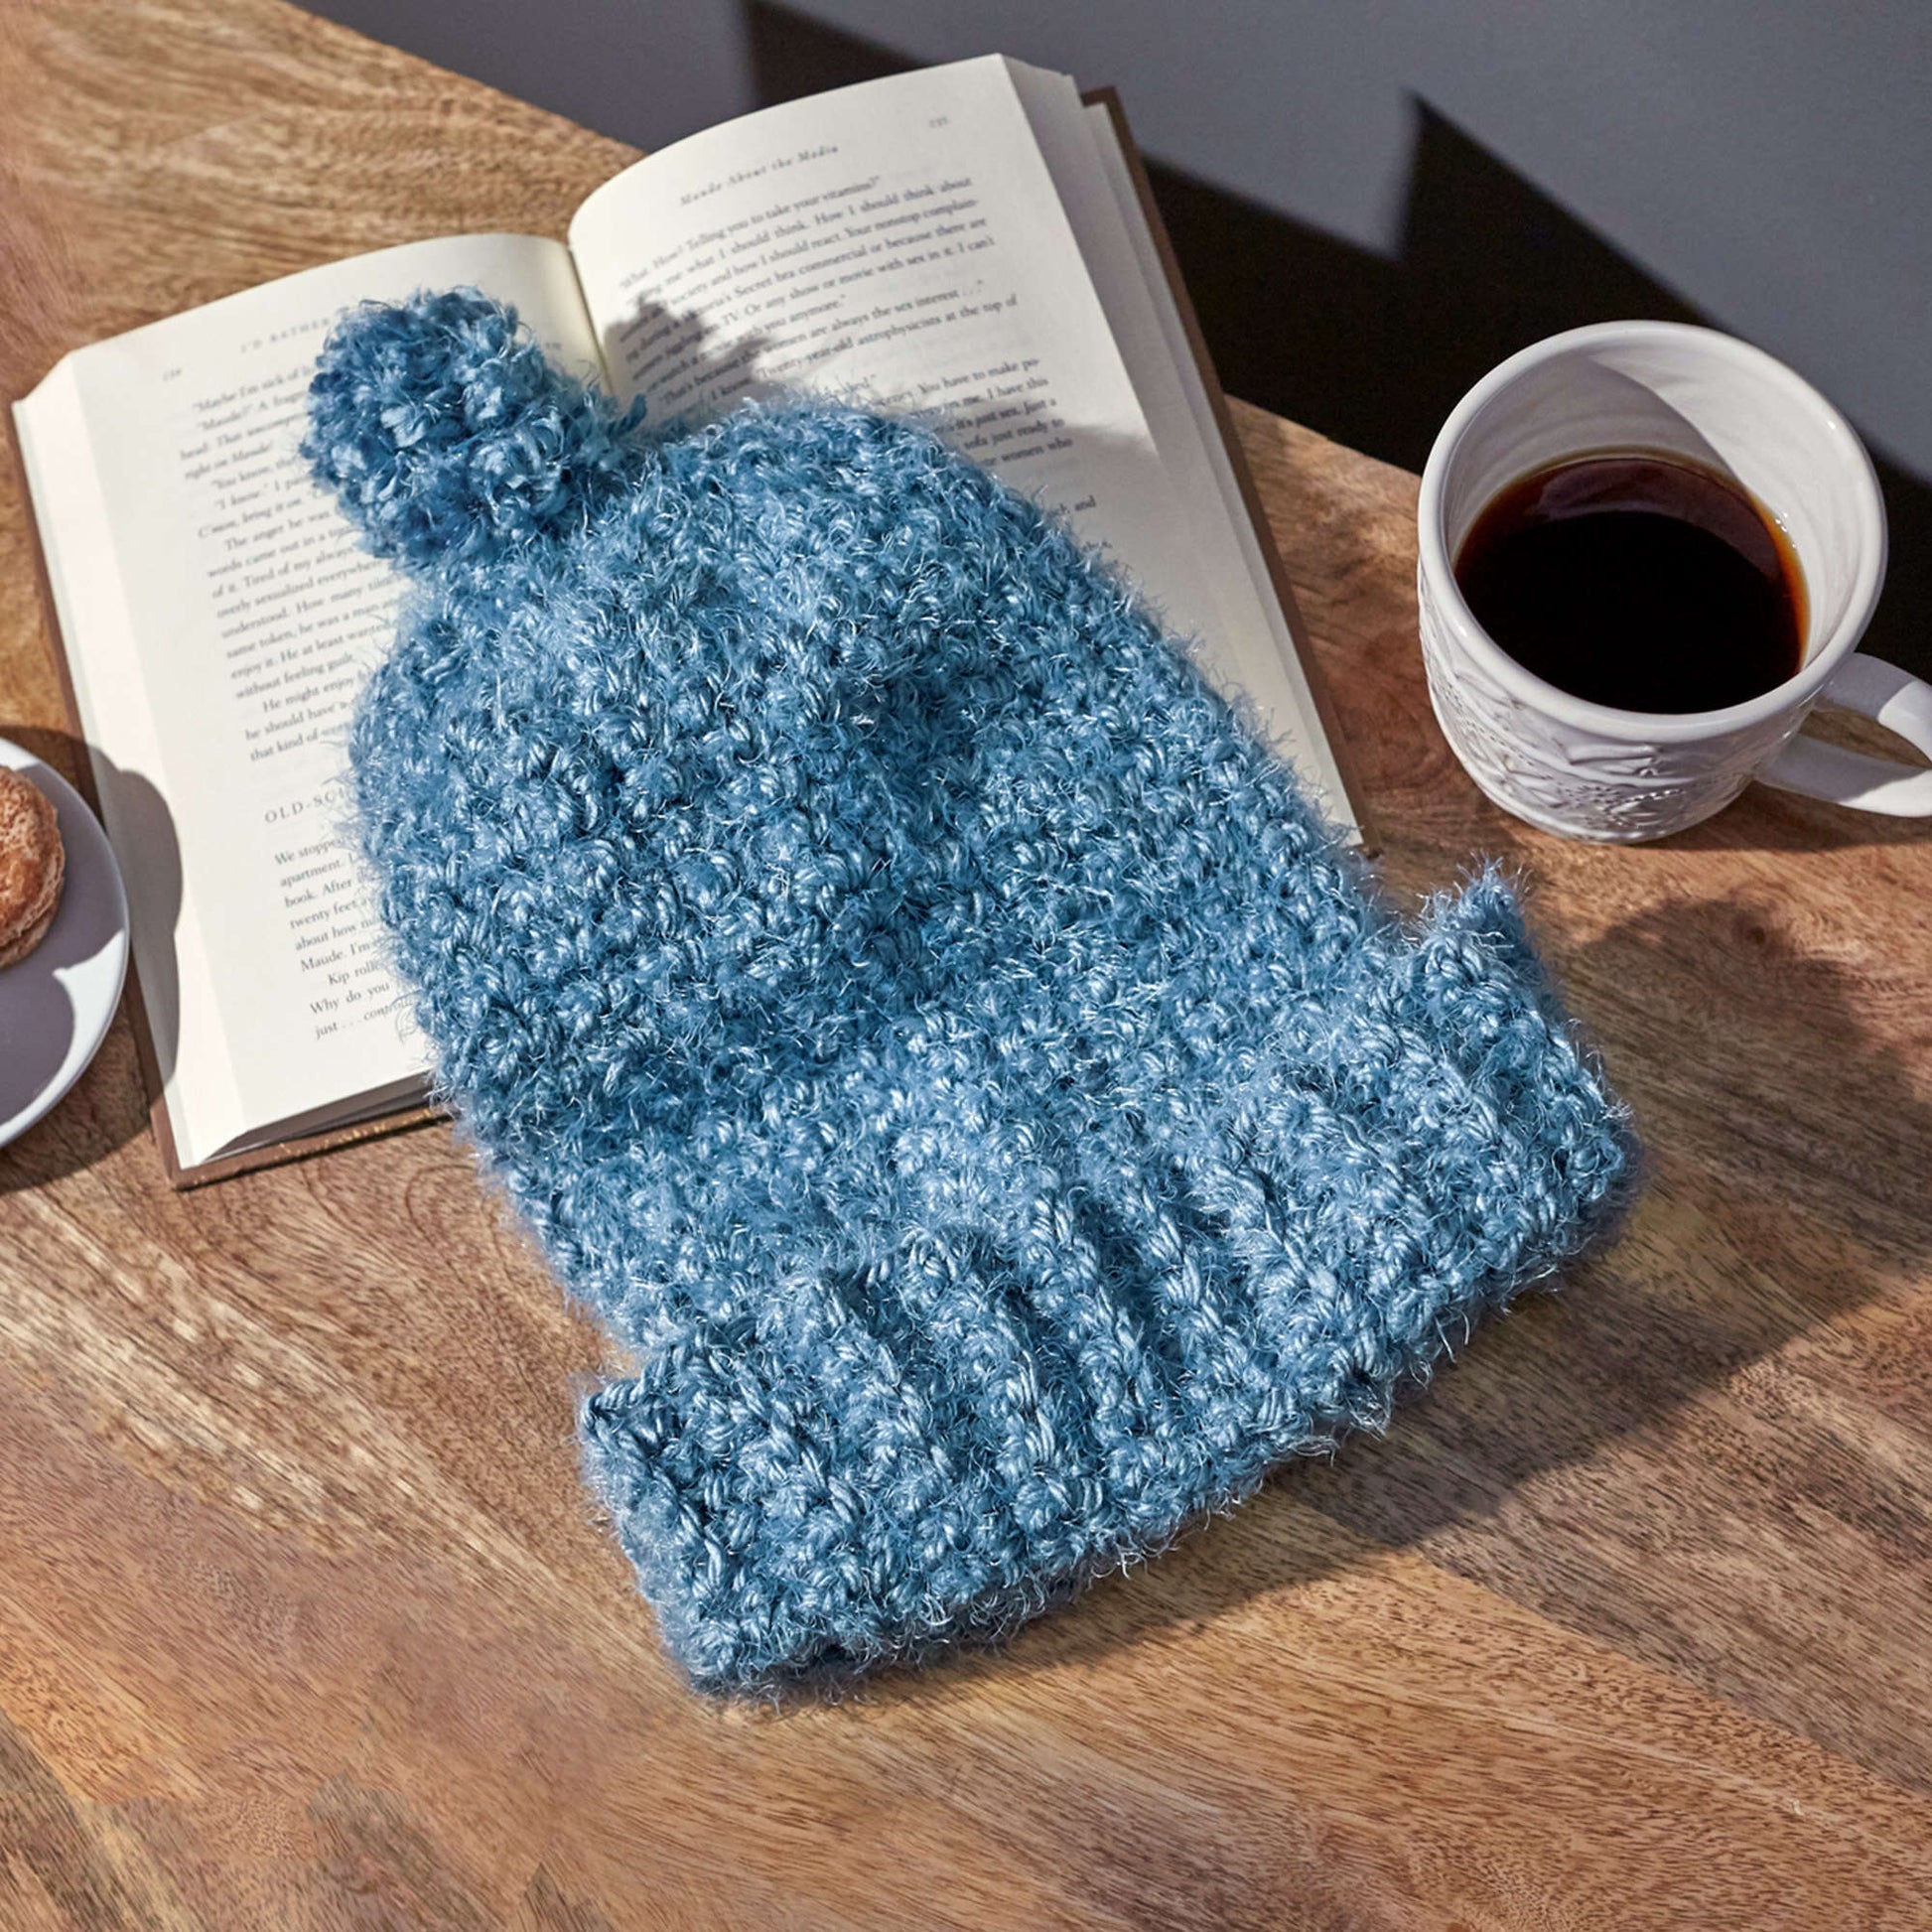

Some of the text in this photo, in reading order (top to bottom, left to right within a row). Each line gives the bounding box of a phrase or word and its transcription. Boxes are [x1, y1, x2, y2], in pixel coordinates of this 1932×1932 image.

[685, 253, 713, 273] what
[731, 230, 768, 254] should
[814, 211, 842, 224] How
[858, 193, 898, 212] should
[902, 184, 933, 202] think
[939, 177, 971, 193] about
[727, 221, 749, 236] you
[749, 215, 763, 226] to
[764, 205, 790, 220] take
[792, 196, 819, 211] your
[711, 267, 733, 285] and
[733, 261, 757, 275] how
[768, 238, 810, 261] should
[843, 224, 872, 238] Your
[874, 212, 919, 230] nonstop
[734, 216, 986, 297] Secret bra commercial or because there are
[788, 284, 819, 299] show
[822, 278, 834, 288] or
[838, 265, 874, 283] movie
[878, 256, 905, 272] with
[905, 254, 925, 265] sex
[927, 249, 941, 260] in
[760, 334, 806, 355] women
[810, 326, 828, 338] are
[831, 313, 869, 331] always
[871, 306, 892, 319] the
[894, 301, 913, 313] sex
[915, 289, 959, 307] interest
[858, 292, 1018, 344] astrophysicists at the top of
[941, 373, 969, 387] have
[971, 369, 986, 379] to
[987, 360, 1018, 375] make
[996, 383, 1025, 396] have
[1026, 375, 1048, 389] this
[241, 507, 271, 523] bring
[222, 518, 302, 550] The anger he
[207, 559, 242, 577] words
[244, 549, 276, 565] came
[280, 539, 299, 553] out
[302, 534, 316, 546] in
[211, 585, 222, 598] of
[242, 568, 274, 587] Tired
[276, 563, 289, 576] of
[292, 559, 311, 571] my
[216, 577, 314, 618] overly sexualized
[296, 600, 324, 614] How
[330, 587, 361, 603] many
[226, 641, 256, 657] same
[298, 622, 313, 634] he
[316, 616, 340, 628] was
[351, 604, 379, 617] man
[230, 662, 261, 678] enjoy
[280, 649, 298, 661] He
[302, 643, 313, 654] at
[316, 633, 344, 651] least
[234, 663, 326, 697] without feeling
[262, 676, 353, 712] He might enjoy
[244, 729, 260, 741] he
[264, 711, 304, 734] should
[307, 704, 336, 719] have
[249, 744, 274, 760] that
[276, 733, 303, 751] kind
[306, 727, 318, 741] of
[274, 853, 294, 865] We
[322, 880, 351, 895] After
[289, 909, 330, 930] twenty
[332, 897, 357, 914] feet
[296, 931, 329, 950] about
[330, 925, 356, 938] how
[328, 971, 349, 985] Kip
[310, 983, 390, 1014] Why do you
[316, 1021, 338, 1038] just
